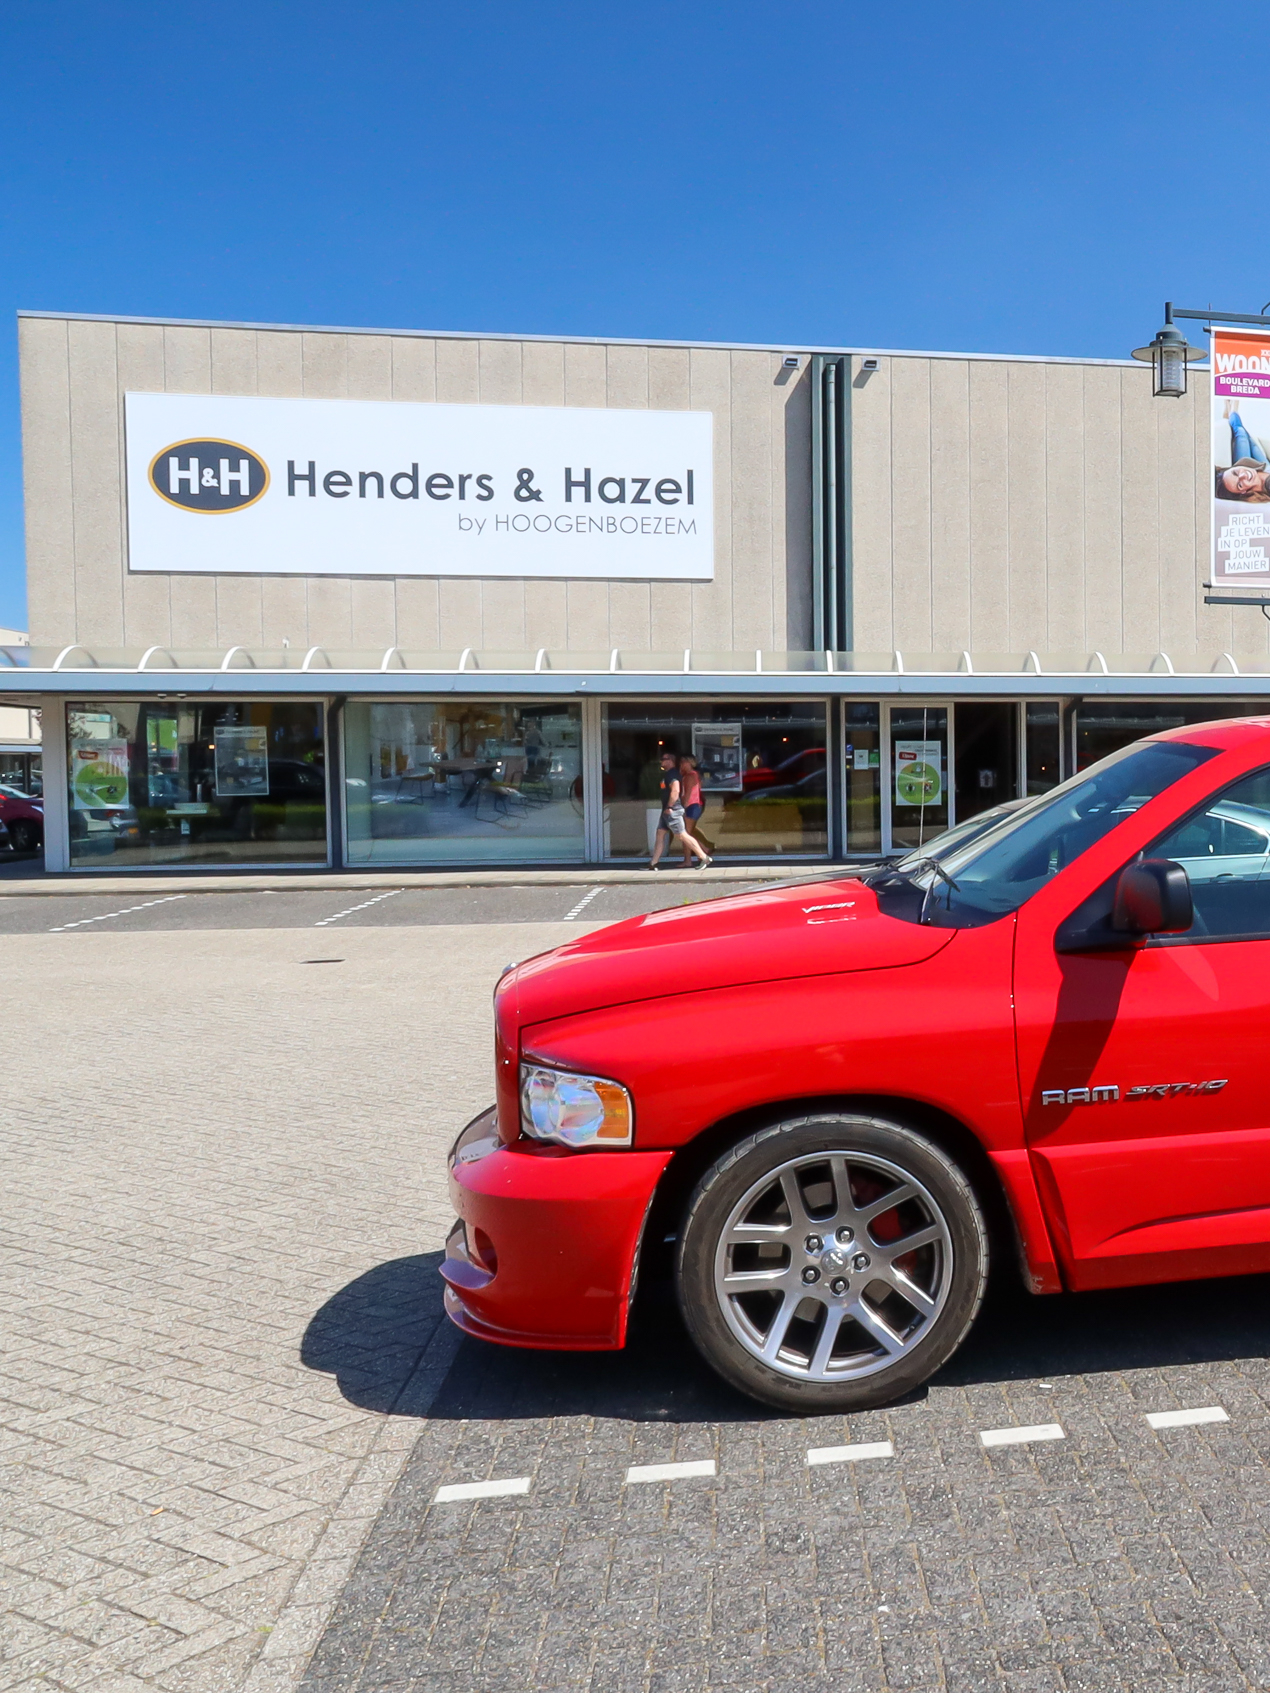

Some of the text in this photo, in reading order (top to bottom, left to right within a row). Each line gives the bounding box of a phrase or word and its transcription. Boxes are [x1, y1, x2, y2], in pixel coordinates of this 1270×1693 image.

[1219, 376, 1270, 387] BOULEVARD
[1230, 385, 1260, 395] BREDA
[168, 456, 250, 496] H&H
[287, 459, 694, 505] Henders & Hazel
[458, 513, 697, 536] by HOOGENBOEZEM
[1231, 515, 1262, 526] RICHT
[1223, 526, 1270, 538] JE LEVEN
[1220, 538, 1247, 549] IN OP
[1232, 549, 1262, 560] JOUW
[1227, 560, 1267, 572] MANIER
[1042, 1084, 1120, 1105] RAM
